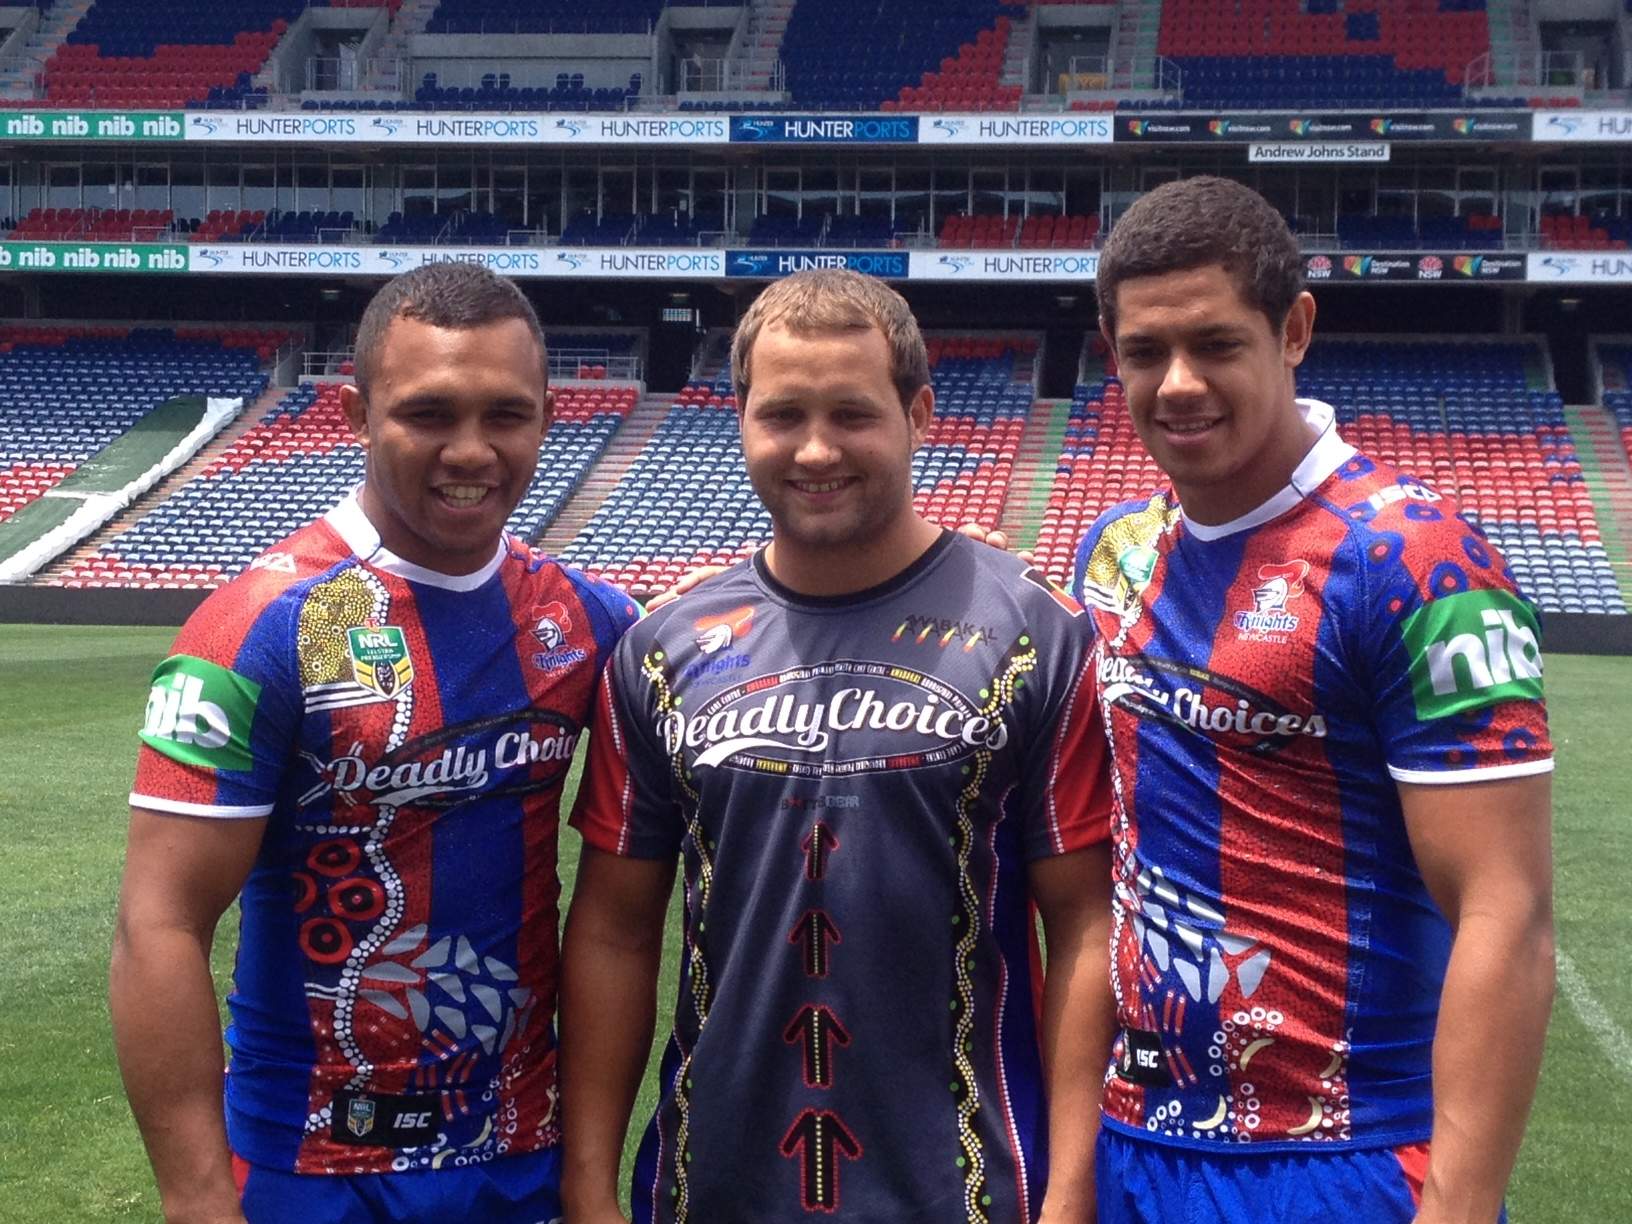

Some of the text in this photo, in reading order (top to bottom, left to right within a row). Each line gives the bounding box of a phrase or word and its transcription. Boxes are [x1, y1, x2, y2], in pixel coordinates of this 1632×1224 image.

[7, 115, 44, 135] nib
[52, 116, 89, 136] nib
[98, 116, 135, 136] nib
[143, 116, 180, 136] nib
[236, 118, 356, 135] HUNTERPORTS
[416, 119, 539, 137] HUNTERPORTS
[600, 120, 724, 137] HUNTERPORTS
[979, 119, 1108, 138] HUNTERPORTS
[1255, 145, 1385, 158] Andrew Johns Stand
[18, 248, 56, 268] nib
[63, 248, 100, 268] nib
[103, 248, 141, 269] nib
[148, 249, 186, 270] nib
[242, 250, 361, 268] HUNTERPORTS
[600, 253, 720, 272] HUNTERPORTS
[984, 256, 1098, 274] HUNTERPORT
[1308, 270, 1331, 278] NSW
[1418, 270, 1442, 279] NSW
[1235, 612, 1298, 633] Knights
[358, 632, 398, 649] NRL
[1426, 609, 1543, 696] nib
[143, 672, 231, 748] nib
[1174, 687, 1328, 738] Choices
[656, 694, 829, 760] Deadly
[828, 687, 1008, 750] Choices
[327, 746, 488, 798] Deadly
[1136, 1048, 1159, 1069] ISC
[393, 1111, 432, 1129] ISC
